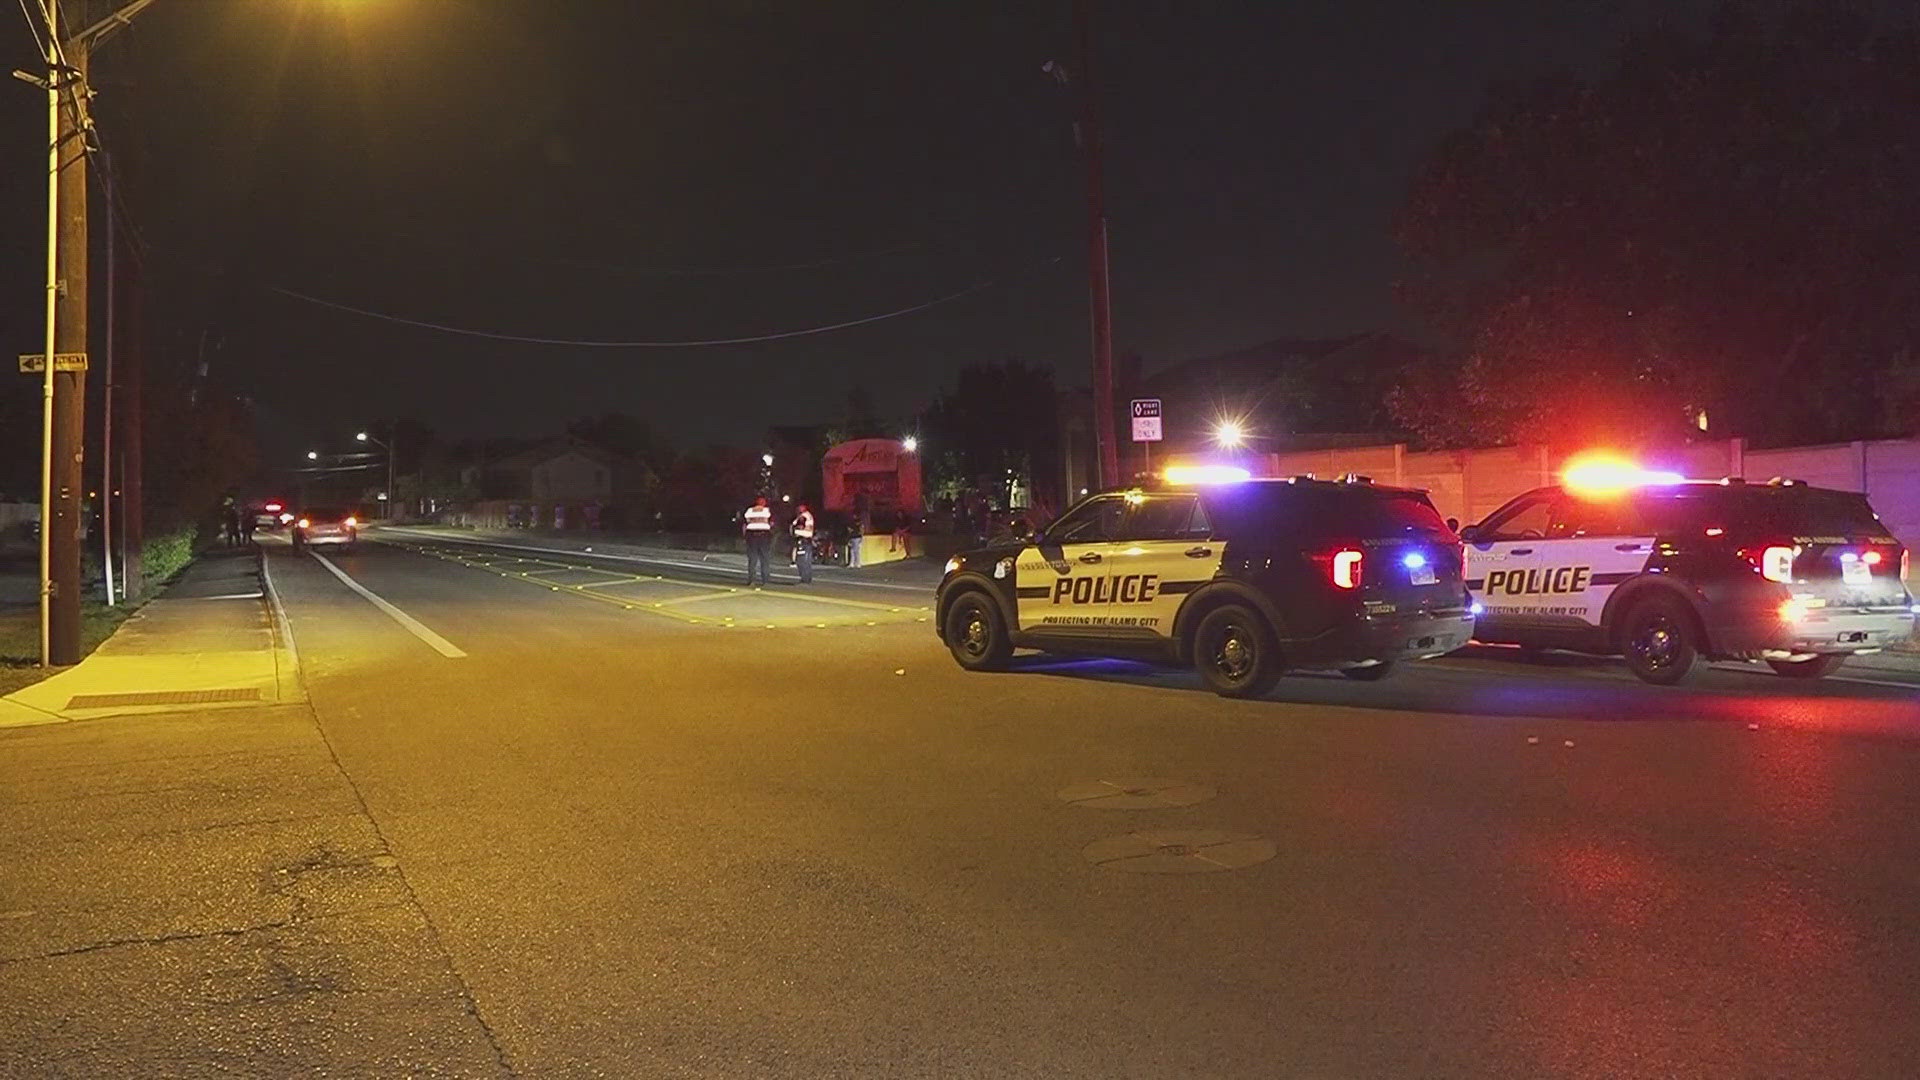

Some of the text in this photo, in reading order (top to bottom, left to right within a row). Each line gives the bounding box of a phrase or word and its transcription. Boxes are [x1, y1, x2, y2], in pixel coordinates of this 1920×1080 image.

[1053, 574, 1158, 605] POLICE
[1486, 566, 1590, 596] POLICE
[1522, 606, 1537, 614] THE
[1540, 606, 1566, 615] ALAMO
[1568, 607, 1588, 615] CITY
[1042, 616, 1160, 627] PROTECTING THE ALAMO CITY
